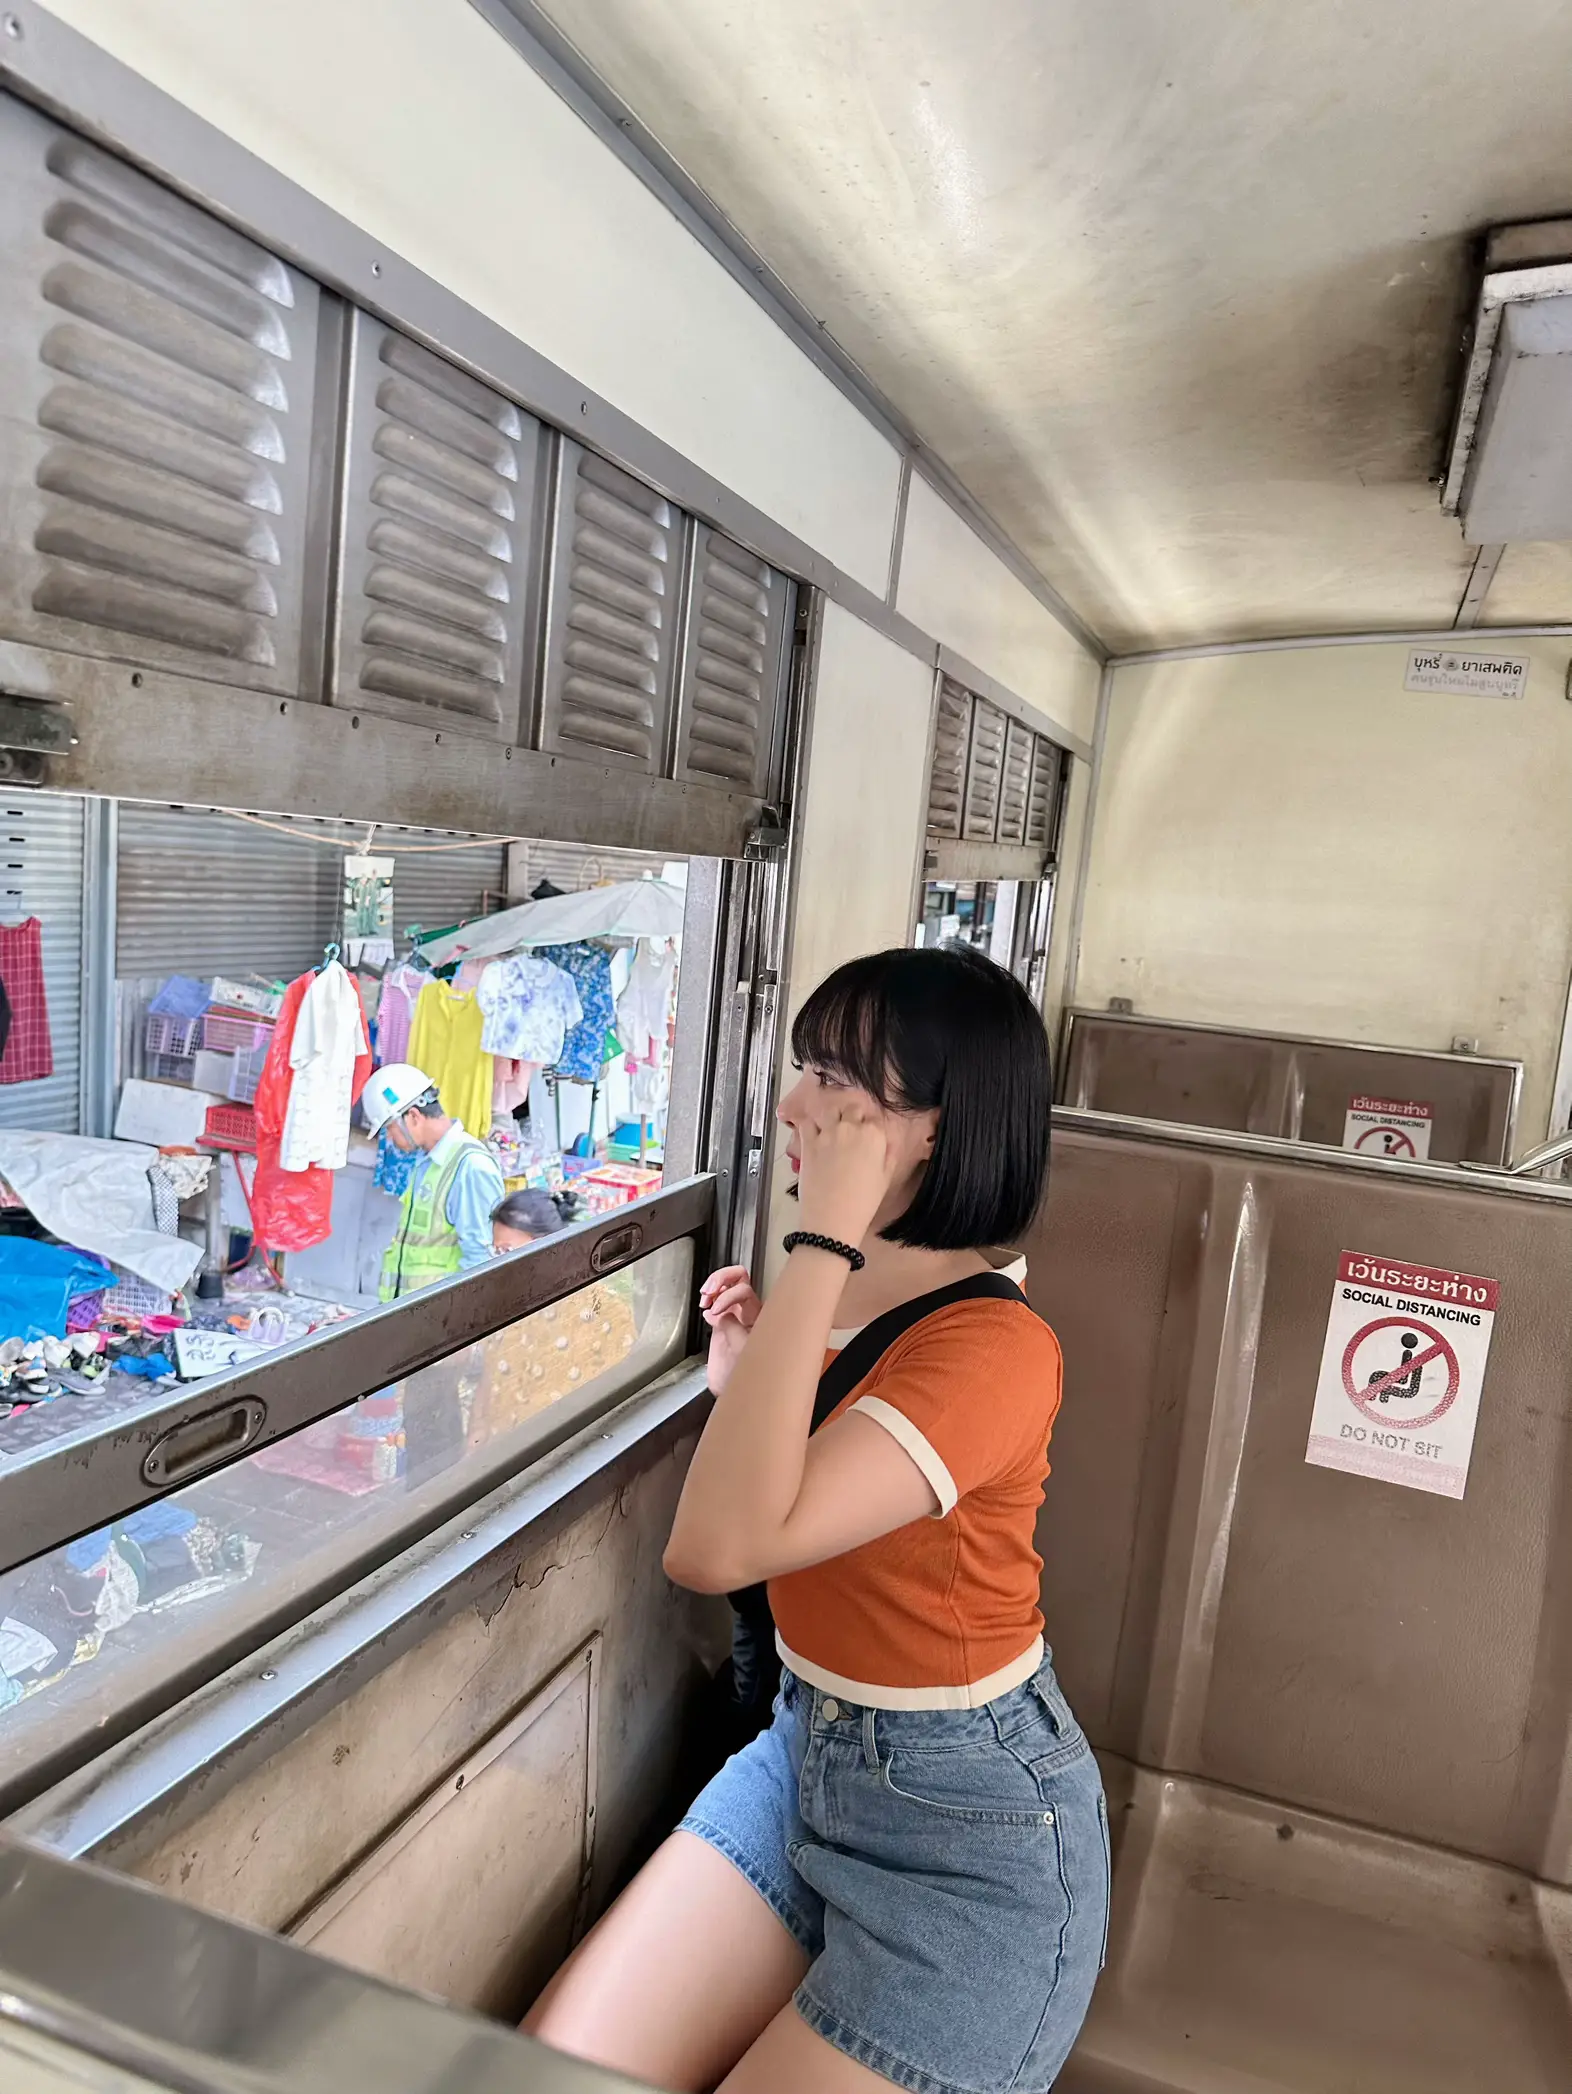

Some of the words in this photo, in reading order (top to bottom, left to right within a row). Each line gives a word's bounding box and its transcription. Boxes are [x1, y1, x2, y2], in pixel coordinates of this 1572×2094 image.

[1351, 1113, 1378, 1122] SOCIAL
[1380, 1116, 1426, 1128] DISTANCING
[1353, 1097, 1428, 1116] เว้นระยะห่าง
[1347, 1258, 1488, 1303] เว้นระยะห่าง
[1342, 1288, 1393, 1309] SOCIAL
[1396, 1299, 1481, 1326] DISTANCING
[1340, 1424, 1367, 1441] DO
[1372, 1431, 1410, 1452] NOT
[1414, 1441, 1444, 1459] SIT
